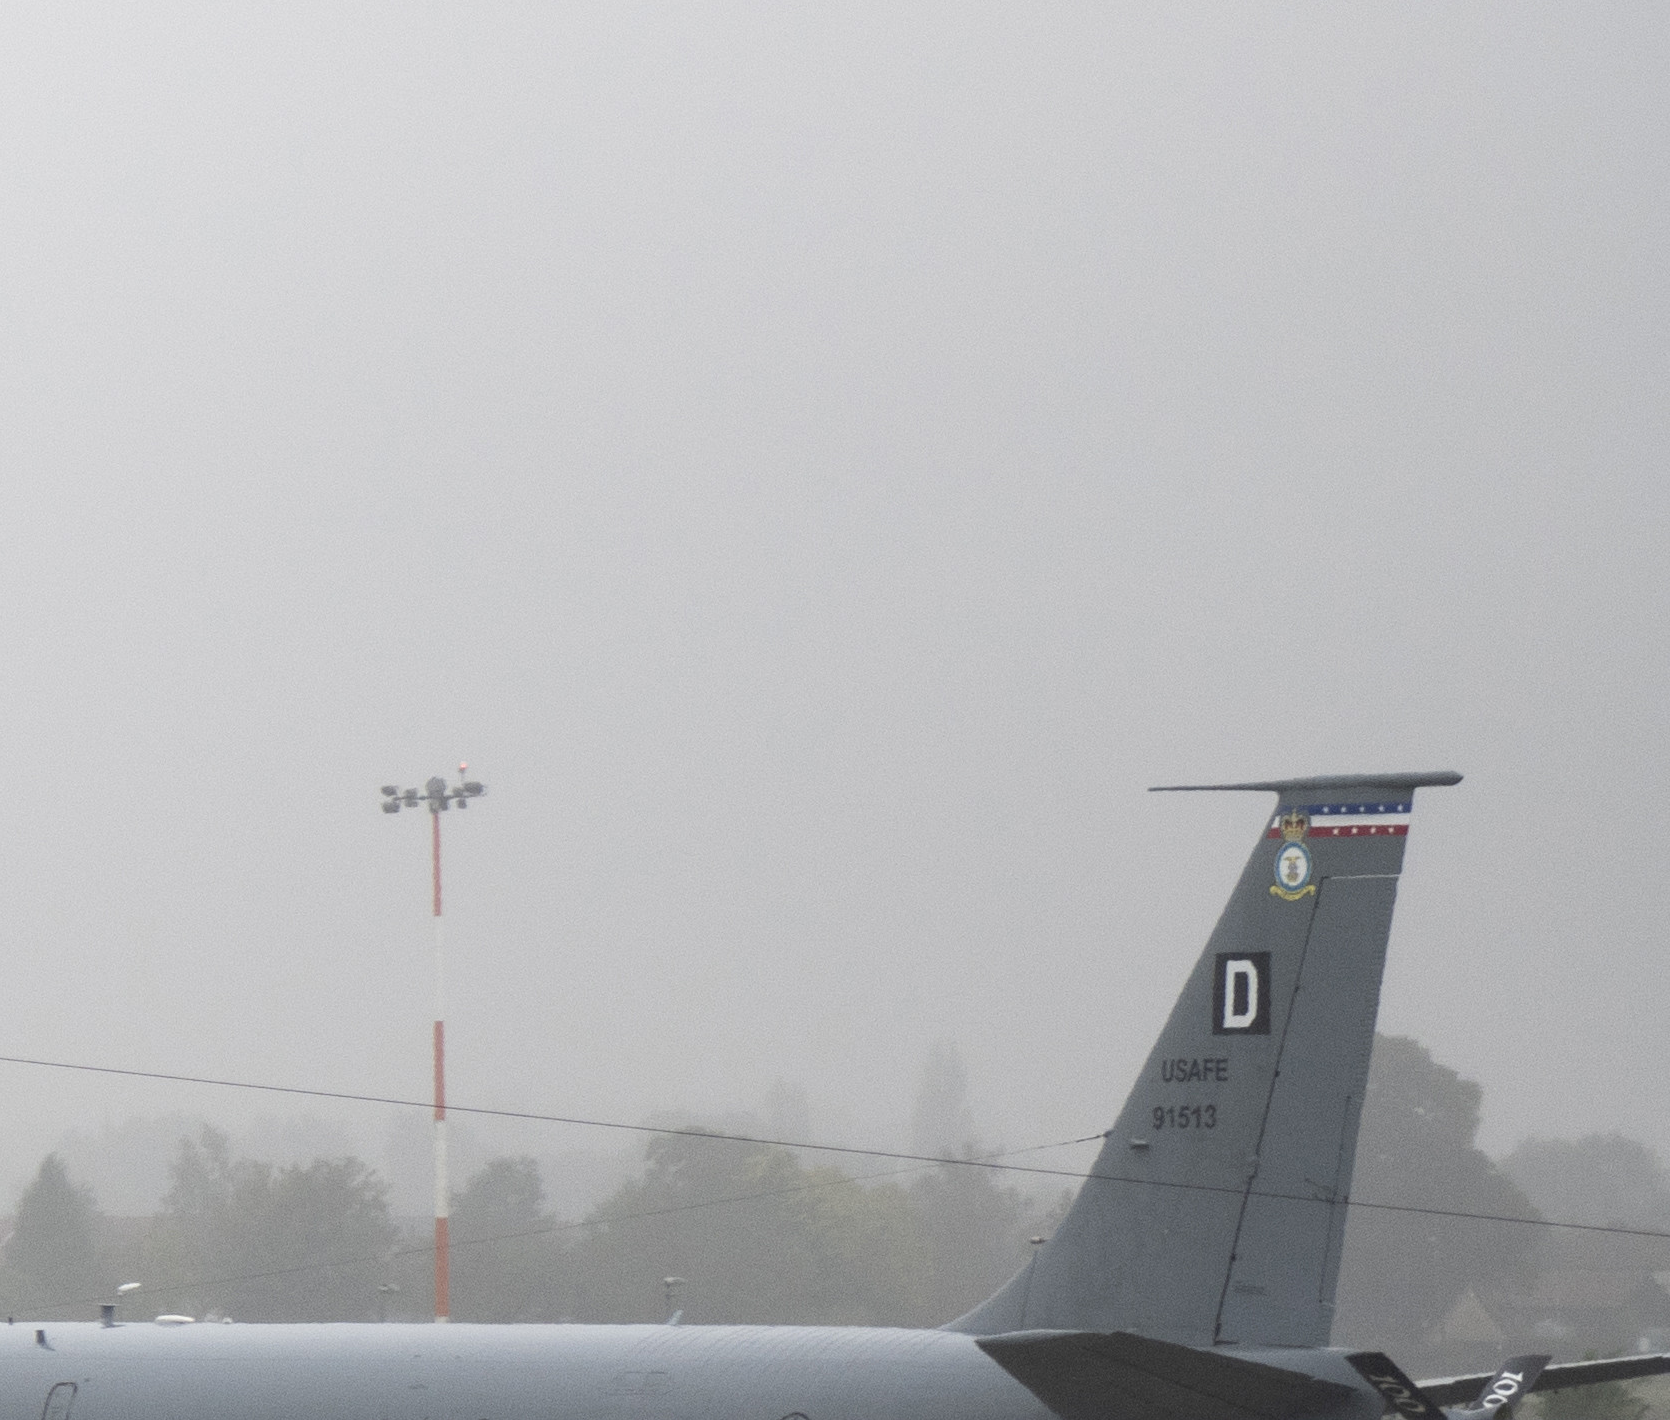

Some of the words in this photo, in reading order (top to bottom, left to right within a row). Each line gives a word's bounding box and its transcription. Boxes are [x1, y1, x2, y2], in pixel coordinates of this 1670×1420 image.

[1223, 959, 1259, 1029] D
[1161, 1058, 1229, 1082] USAFE
[1152, 1104, 1217, 1130] 91513
[1369, 1374, 1426, 1413] 100
[1482, 1371, 1523, 1409] 100
